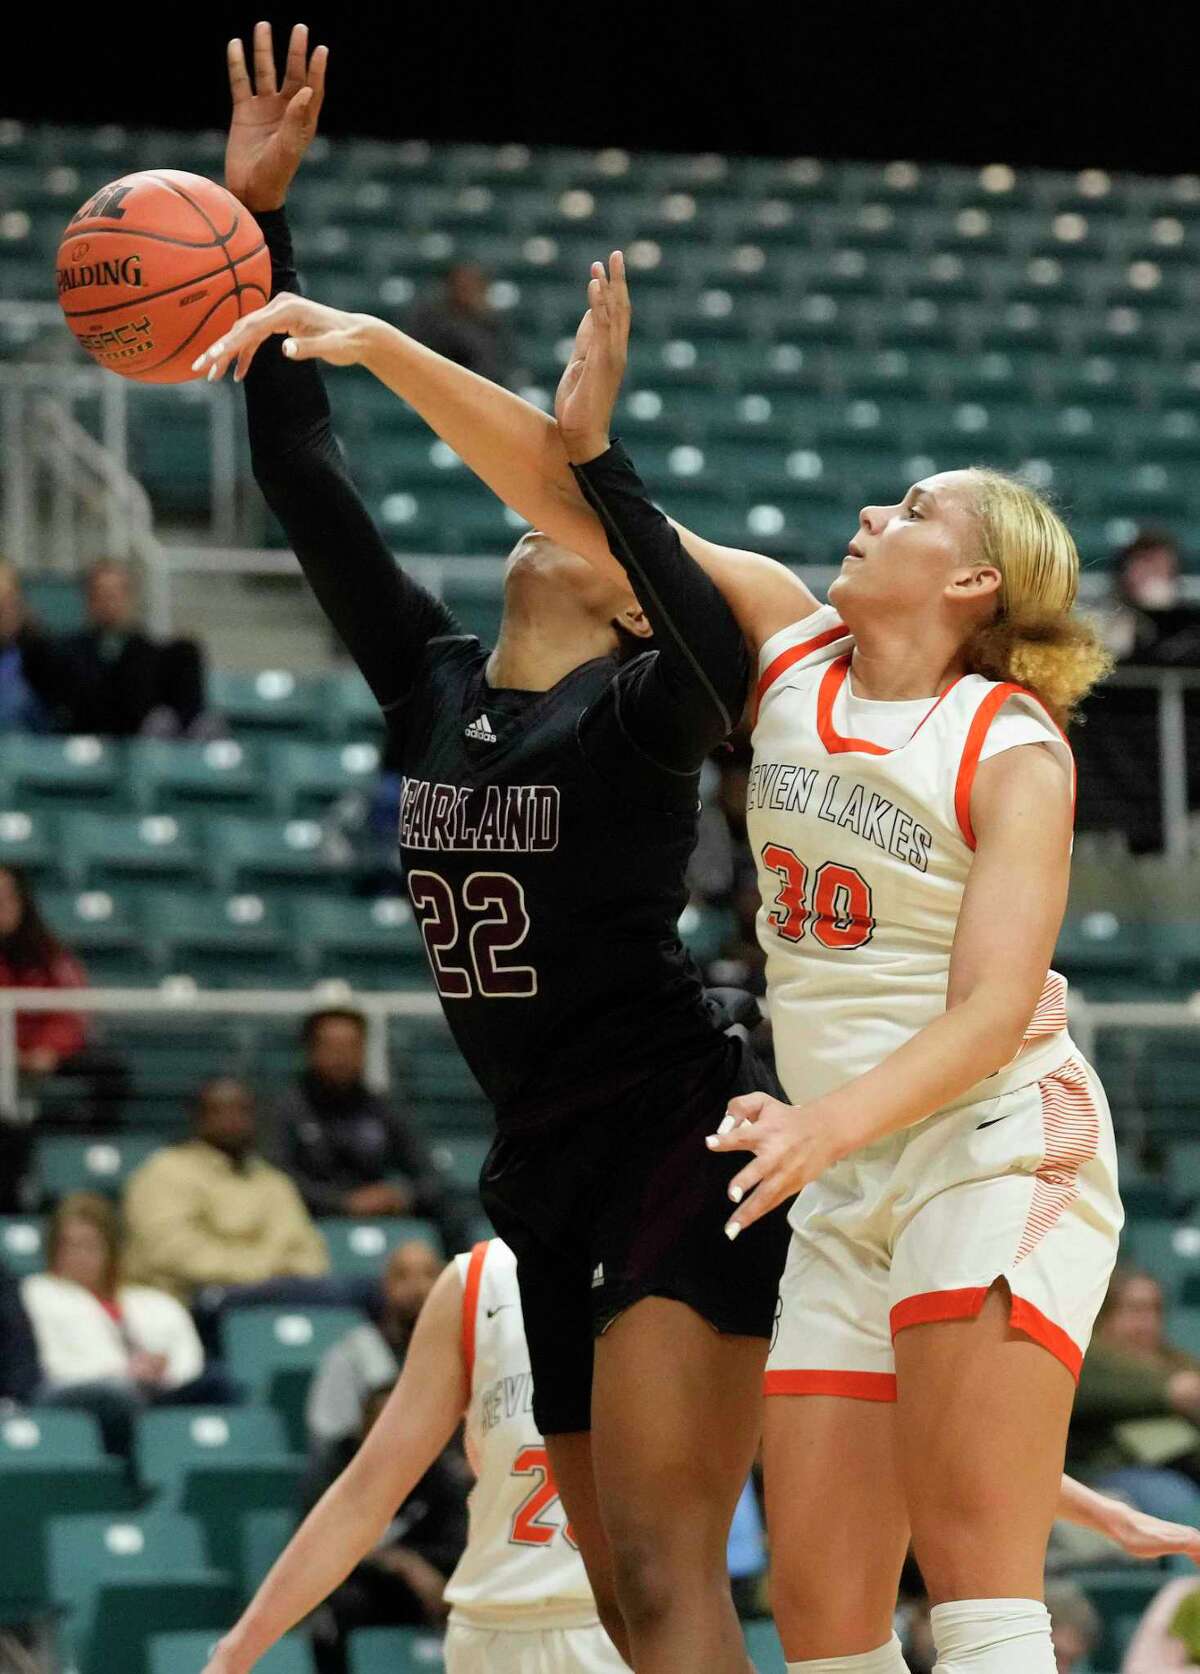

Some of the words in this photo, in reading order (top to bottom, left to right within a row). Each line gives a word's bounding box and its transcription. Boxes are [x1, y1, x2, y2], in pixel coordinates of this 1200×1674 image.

[55, 254, 143, 294] PALDING
[76, 315, 152, 350] EGACY
[464, 727, 498, 743] adidas
[399, 775, 561, 853] EARLAND
[746, 763, 820, 814] EVEN
[817, 774, 933, 873] LAKES
[407, 869, 538, 999] 22
[760, 841, 877, 951] 30
[481, 1372, 534, 1437] SEV
[508, 1444, 579, 1551] 2
